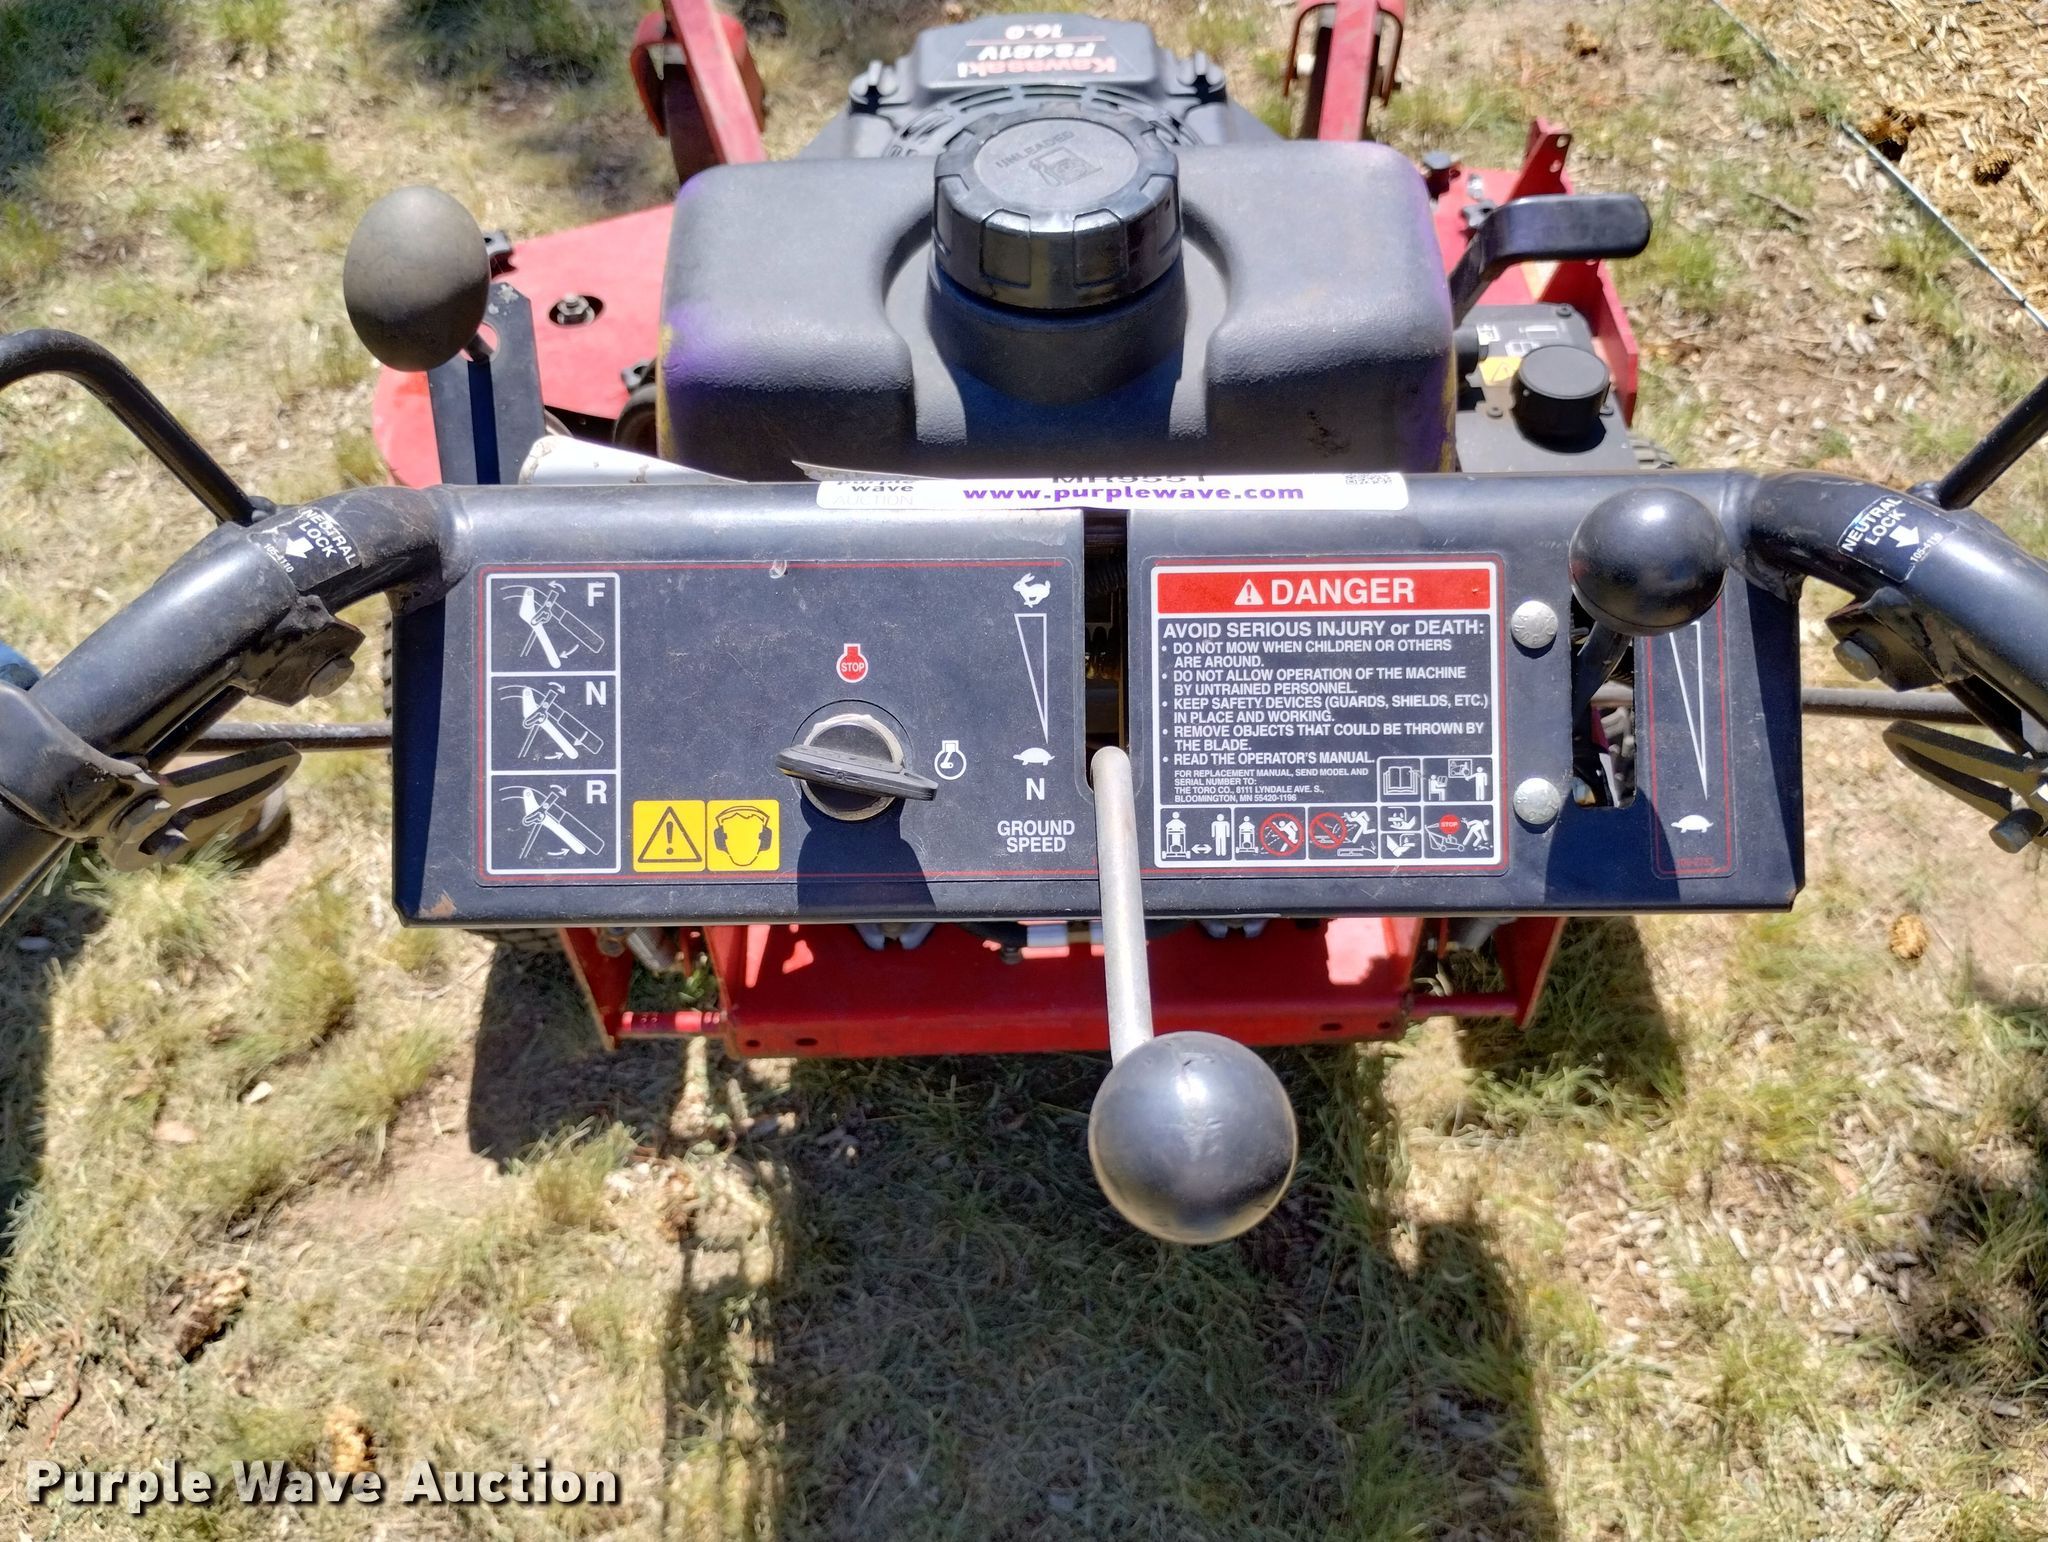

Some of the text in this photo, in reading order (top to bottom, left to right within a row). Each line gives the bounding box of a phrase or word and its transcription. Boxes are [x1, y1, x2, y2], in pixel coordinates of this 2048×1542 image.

[995, 131, 1075, 168] UNLEADED
[963, 486, 1304, 502] www.purplewave.com
[1841, 498, 1903, 552] NEUTRAL
[1864, 508, 1906, 545] LOCK
[299, 521, 337, 558] LOCK
[588, 582, 606, 607] F
[1271, 577, 1415, 605] DANGER
[1163, 620, 1484, 638] AVOID SERIOUS INJURY or DEATH:
[1174, 639, 1452, 654] DO NOT MOW WHEN CHILDREN OR OTHERS
[841, 662, 864, 672] STOP
[1174, 656, 1264, 668] ARE AROUND.
[1174, 666, 1466, 682] DO NOT ALLOW OPERATION OF THE MACHINE
[586, 681, 607, 705] N
[1174, 682, 1358, 696] BY UNTRAINED PERSONNEL.
[1174, 694, 1488, 710] KEEP SAFETY DEVICES (GUARDS, SHIELDS, ETC.)
[1174, 710, 1335, 724] IN PLACE AND WORKING.
[1174, 722, 1484, 737] REMOVE OBJECTS THAT COULD BE THROWN BY
[1175, 739, 1252, 751] THE BLADE.
[1174, 752, 1375, 765] READ THE OPERATOR'S MANUAL.
[1175, 770, 1191, 778] FOR
[1193, 769, 1254, 778] REPLACEMENT
[1256, 769, 1294, 778] MANUAL,
[1320, 768, 1349, 776] MODEL
[1350, 768, 1368, 776] AND
[1026, 778, 1045, 800] N
[1175, 778, 1204, 786] SERIAL
[1218, 786, 1234, 794] CO.,
[1236, 786, 1253, 794] 8111
[1255, 785, 1292, 793] LYNDALE
[1294, 785, 1312, 793] AVE.
[586, 780, 607, 804] R
[1175, 795, 1238, 803] BLOOMINGTON,
[998, 820, 1075, 836] GROUND
[1006, 836, 1066, 852] SPEED
